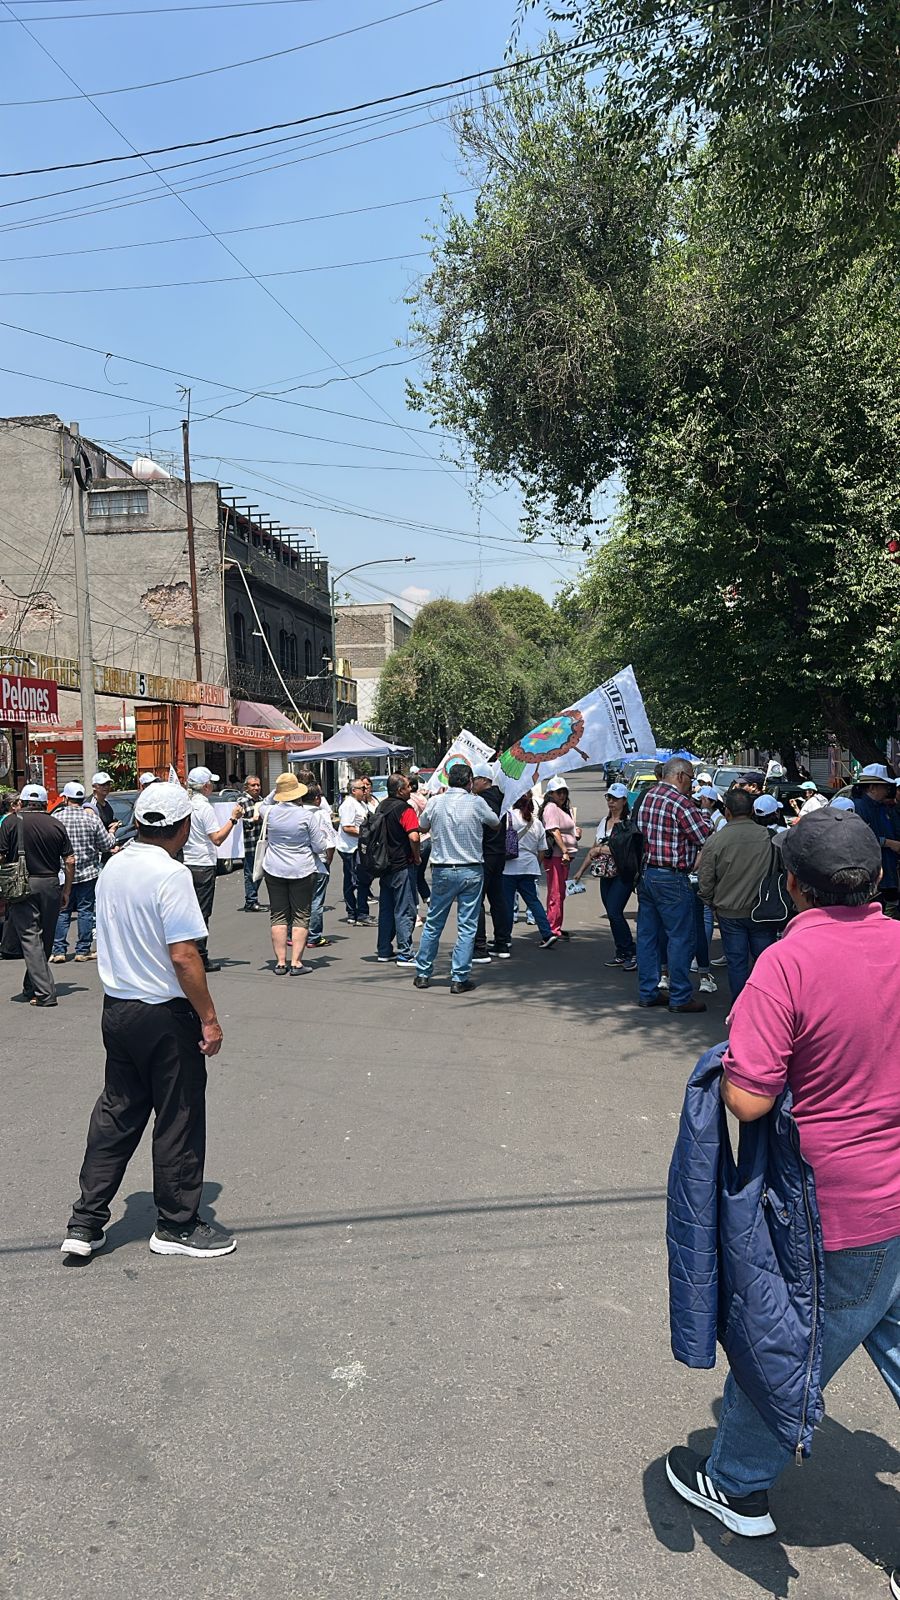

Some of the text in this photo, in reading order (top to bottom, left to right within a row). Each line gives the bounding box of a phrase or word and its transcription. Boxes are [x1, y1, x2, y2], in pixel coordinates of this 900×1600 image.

[2, 678, 50, 712] Pelones
[140, 674, 146, 696] 5
[197, 723, 225, 734] TORTAS
[232, 728, 271, 739] GORDITAS
